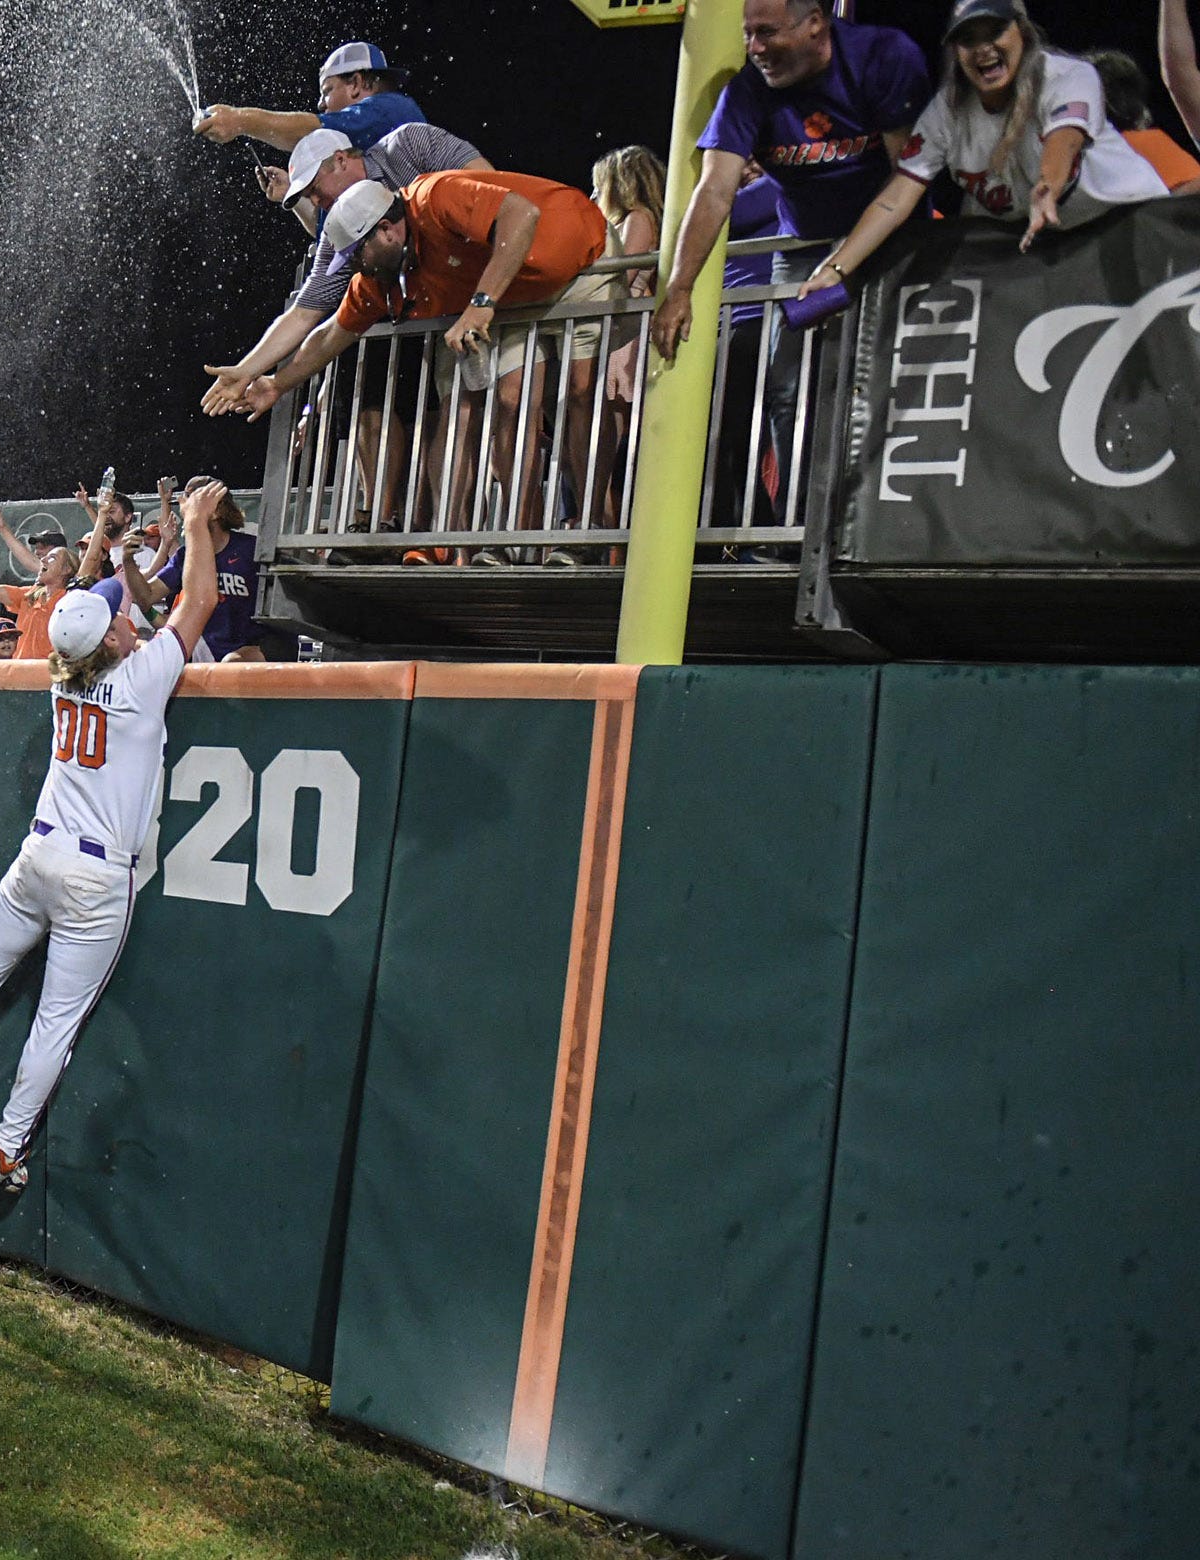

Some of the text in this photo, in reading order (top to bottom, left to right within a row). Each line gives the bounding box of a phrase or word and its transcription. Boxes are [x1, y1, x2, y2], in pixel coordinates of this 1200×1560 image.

[879, 279, 983, 501] THE
[217, 572, 250, 597] ERS
[55, 696, 108, 770] 00
[136, 745, 361, 917] 20
